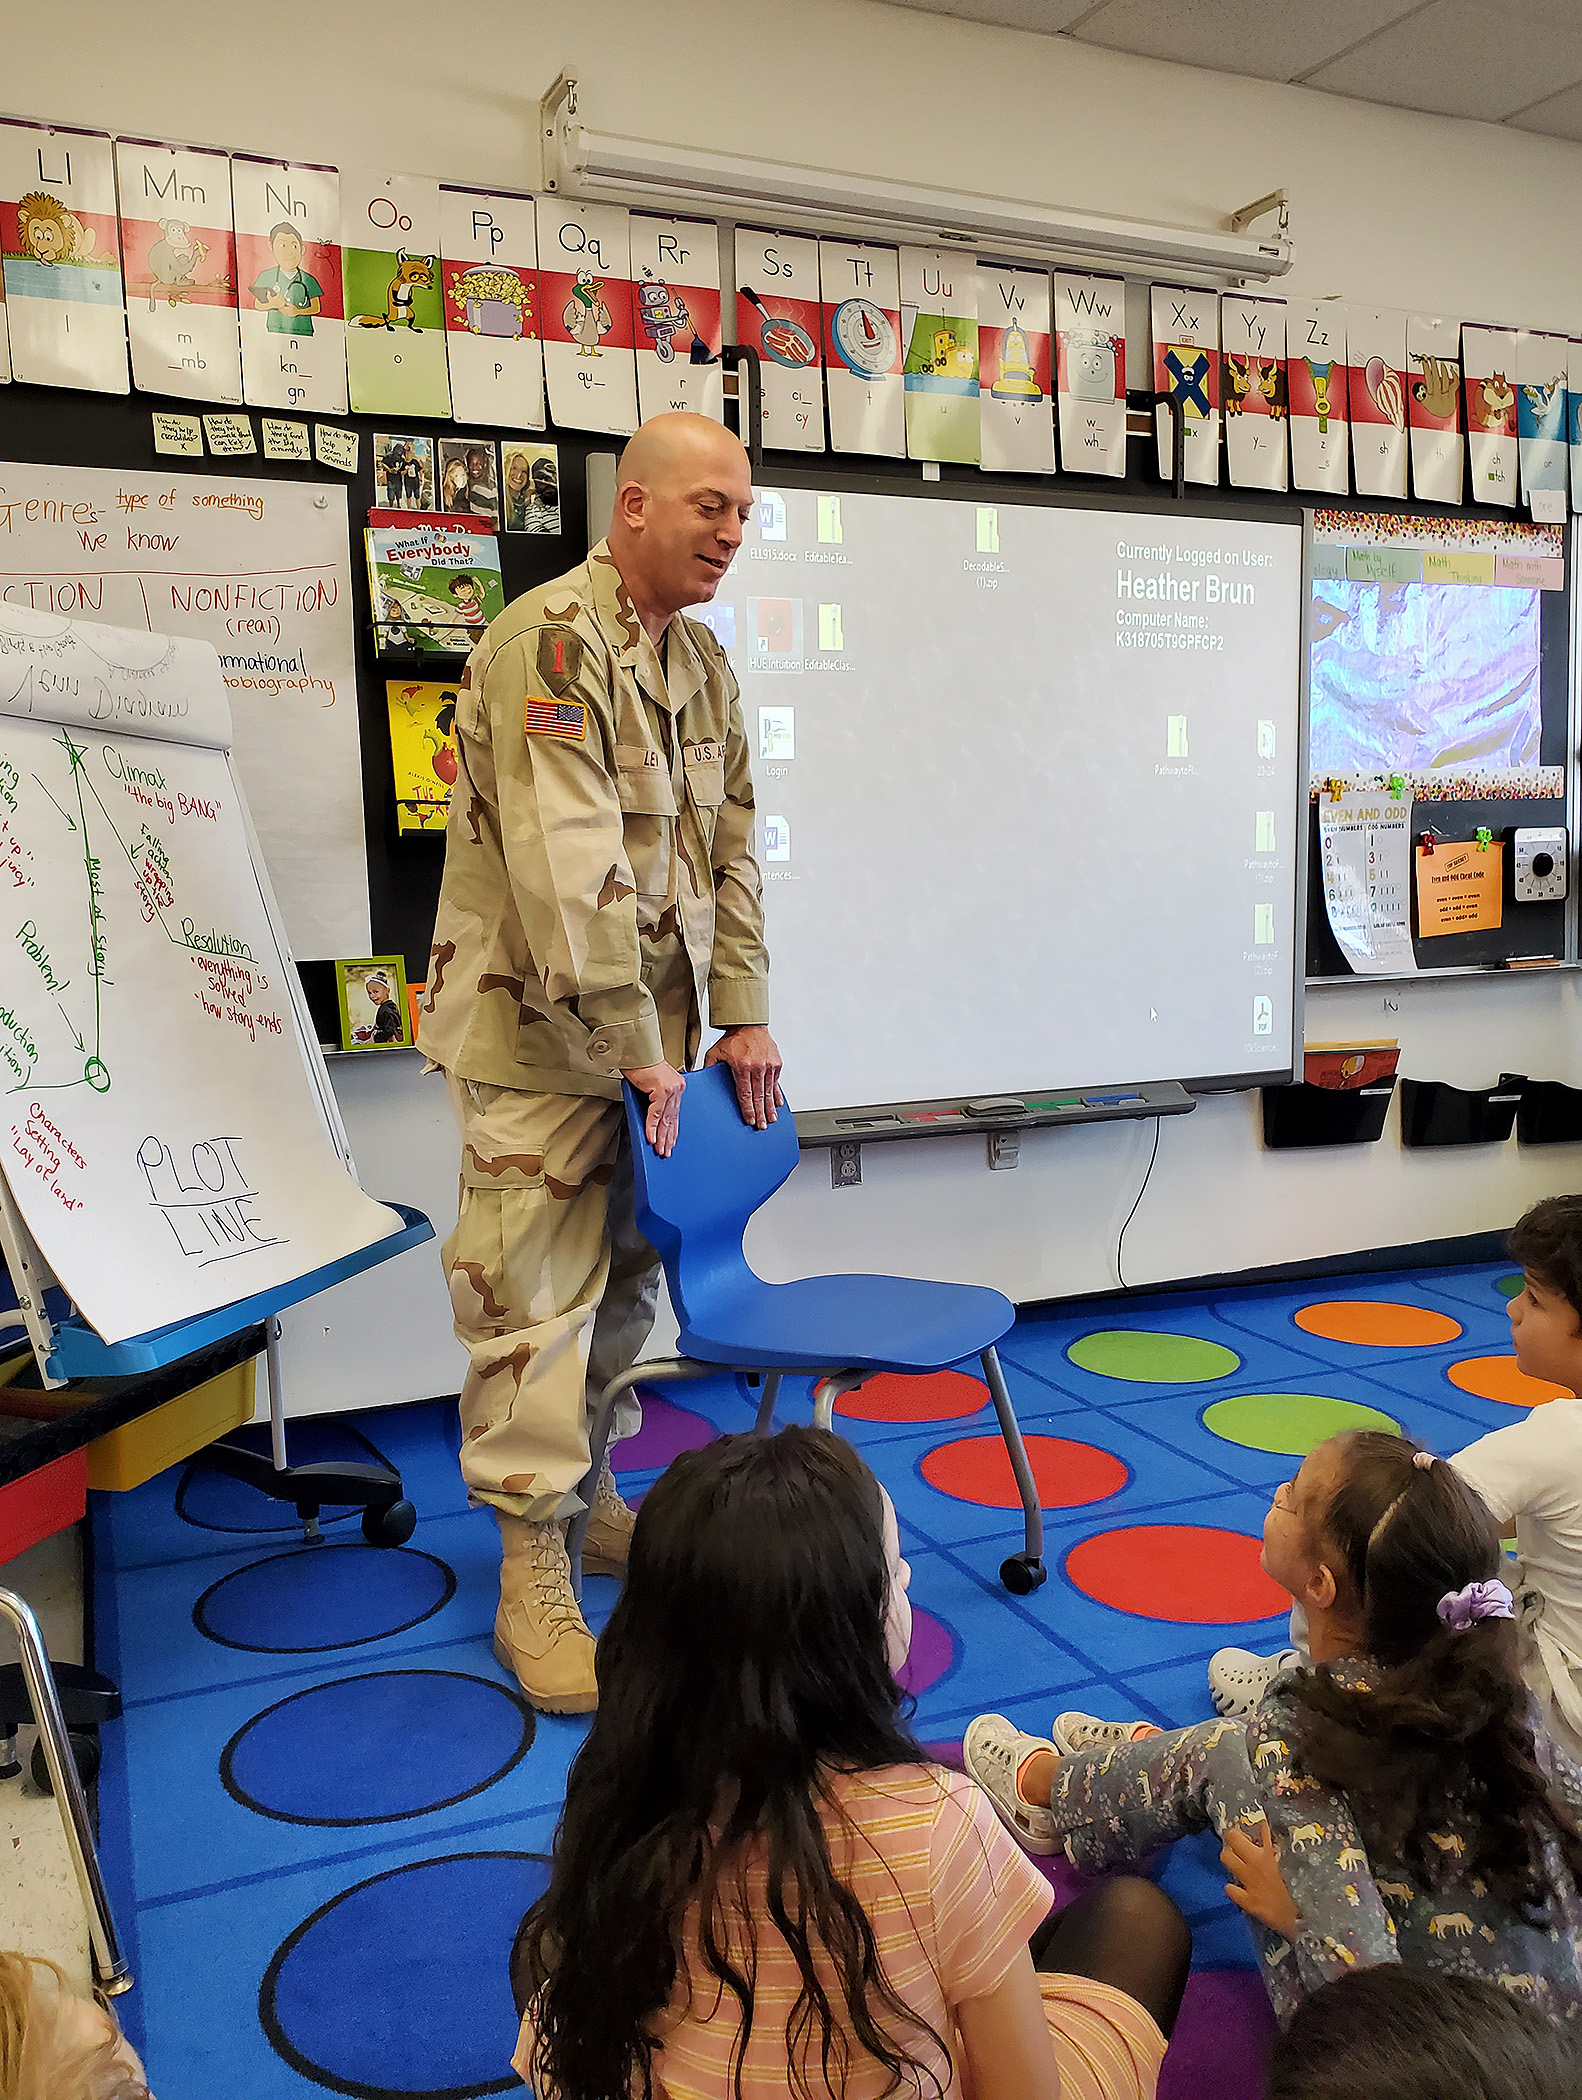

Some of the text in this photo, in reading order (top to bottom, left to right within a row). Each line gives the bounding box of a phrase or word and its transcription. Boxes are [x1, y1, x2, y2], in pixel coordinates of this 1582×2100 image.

[143, 164, 206, 204] Mm
[265, 182, 307, 218] Nn
[367, 197, 413, 231] Oo
[471, 210, 504, 255] Pp
[558, 222, 610, 270] Qq
[657, 234, 690, 265] Rr
[762, 248, 793, 278] Ss
[847, 258, 873, 288] Tt
[923, 268, 953, 297] Uu
[998, 283, 1025, 311] Vv
[1067, 287, 1112, 318] Ww
[1172, 302, 1199, 330] Xx
[1241, 312, 1266, 350] Yy
[177, 332, 192, 345] m
[290, 339, 299, 350] n
[1306, 319, 1329, 346] Zz
[494, 362, 503, 380] p
[679, 378, 687, 388] r
[287, 385, 306, 405] gn
[670, 400, 688, 410] wr
[796, 413, 809, 429] cy
[116, 488, 264, 521] type of something
[77, 526, 180, 553] We know
[385, 542, 471, 562] Everybody
[395, 539, 419, 549] What
[1116, 541, 1273, 568] Currently Logged on User:
[431, 558, 474, 566] Did That?
[170, 577, 338, 613] NONFICTION
[1117, 569, 1255, 605] Heather Brun
[226, 615, 281, 645] (real)
[1116, 609, 1209, 629] Computer Name:
[219, 648, 307, 676] rmational
[552, 641, 564, 674] 1
[765, 765, 788, 779] Login
[156, 793, 175, 824] big
[1324, 807, 1407, 822] EVEN AND ODD
[1368, 851, 1375, 863] 3
[1369, 869, 1375, 880] 5
[1370, 886, 1376, 897] 7
[180, 917, 252, 960] Resolution
[197, 956, 269, 994] everything is
[207, 976, 246, 1008] solved
[200, 990, 282, 1043] how story ends
[24, 1119, 61, 1175] Setting
[30, 1102, 87, 1169] Characters
[137, 1135, 248, 1201] PLOT
[161, 1199, 278, 1256] LINE
